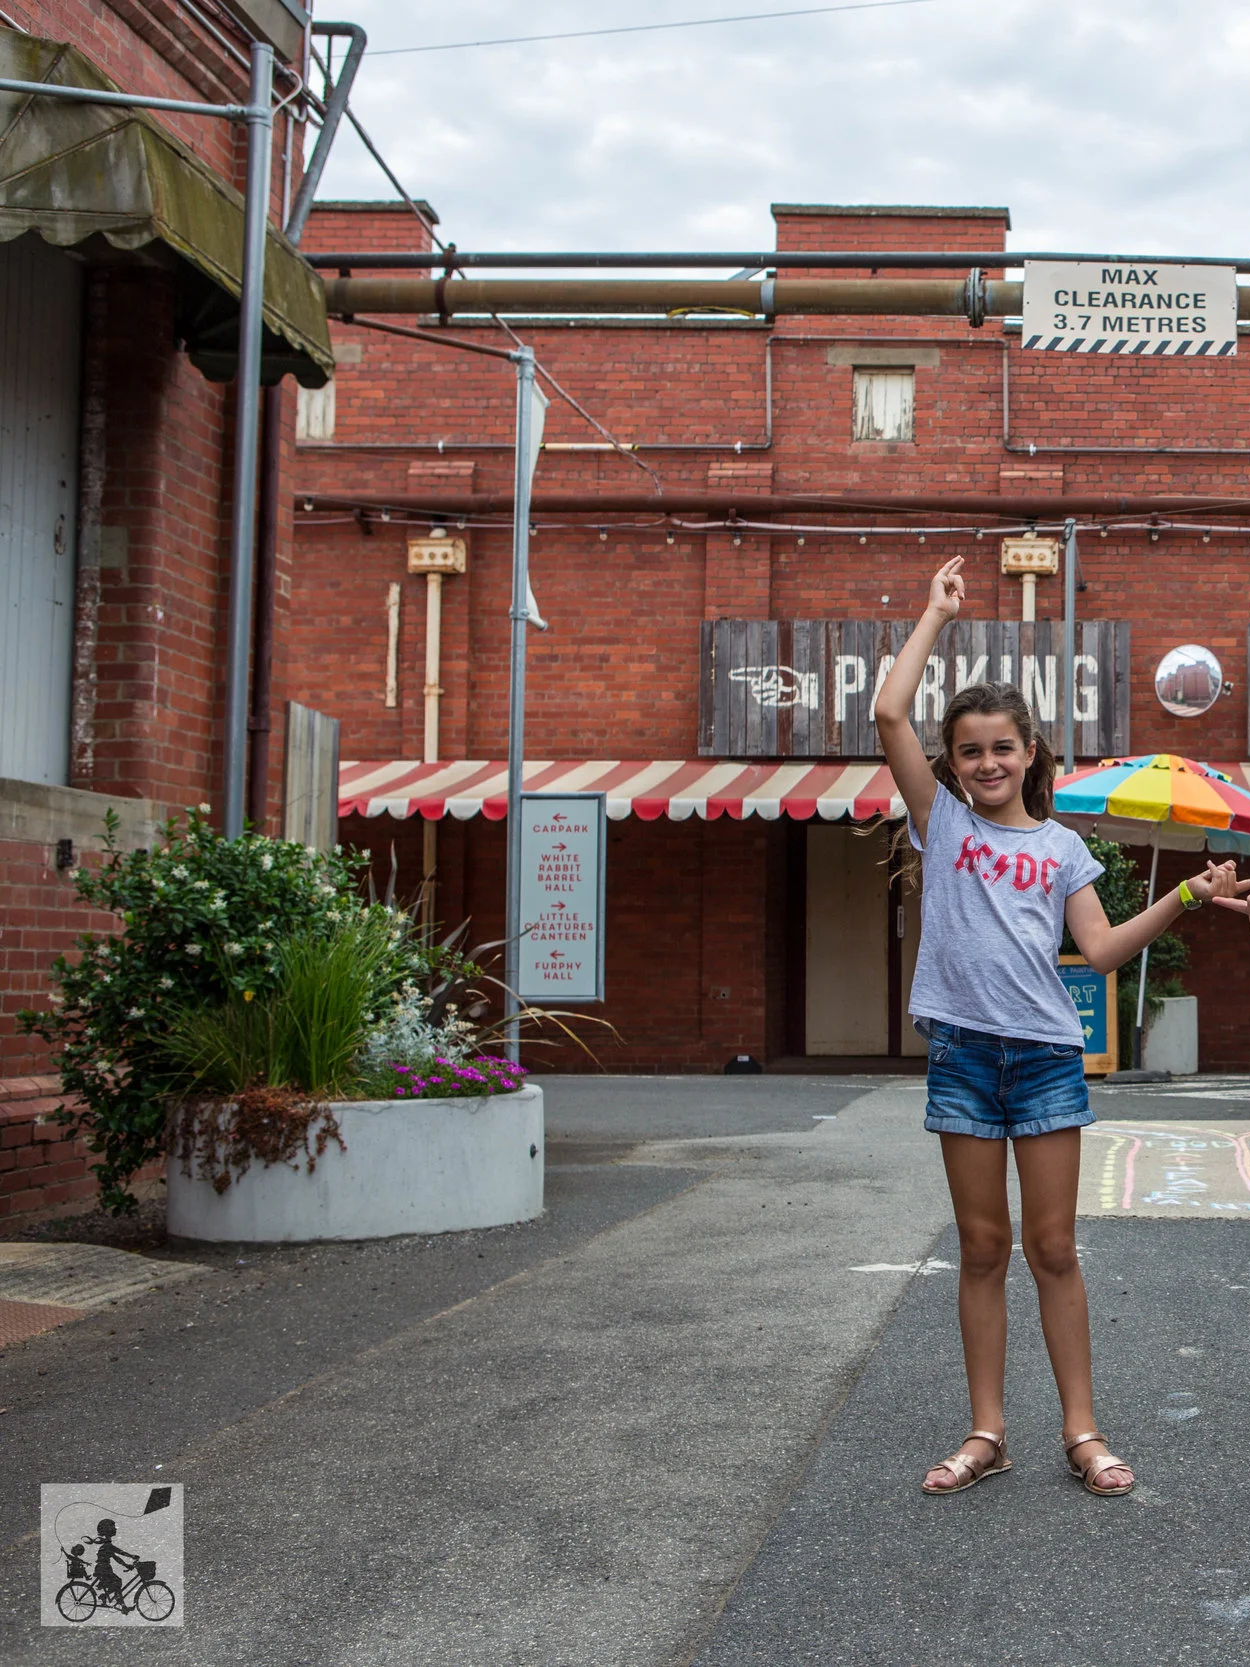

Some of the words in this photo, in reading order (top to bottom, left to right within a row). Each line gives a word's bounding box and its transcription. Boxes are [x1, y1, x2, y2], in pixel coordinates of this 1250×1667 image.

[1101, 268, 1158, 286] MAX
[1054, 289, 1207, 309] CLEARANCE
[1053, 313, 1092, 331] 3.7
[1102, 315, 1207, 333] METRES
[532, 824, 589, 833] CARPARK
[541, 854, 580, 863] WHITE
[538, 864, 581, 872] RABBIT
[537, 874, 583, 882] BARREL
[545, 884, 575, 892] HALL
[539, 912, 579, 921] LITTLE
[524, 922, 594, 931] CREATURES
[531, 932, 587, 941] CANTEEN
[535, 962, 583, 970] FURPHY
[544, 972, 574, 980] HALL
[1069, 985, 1097, 1003] RT
